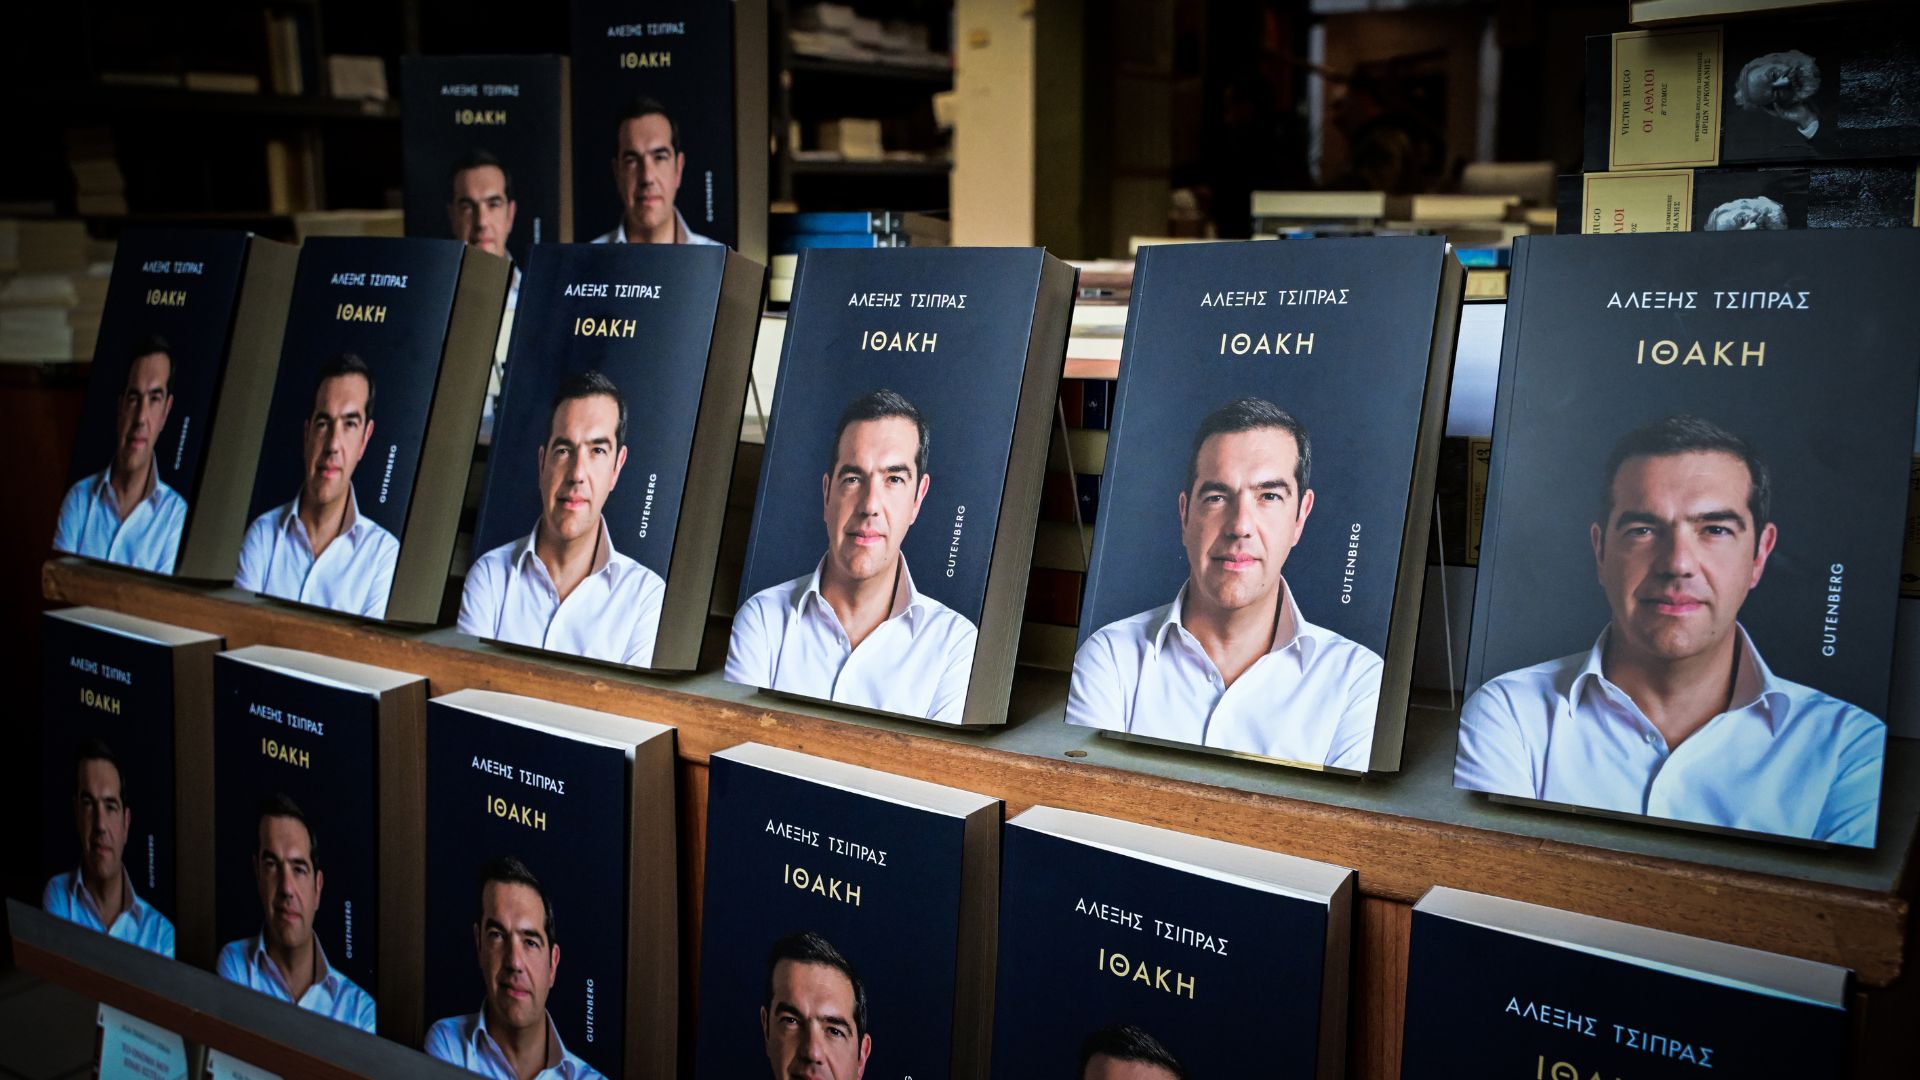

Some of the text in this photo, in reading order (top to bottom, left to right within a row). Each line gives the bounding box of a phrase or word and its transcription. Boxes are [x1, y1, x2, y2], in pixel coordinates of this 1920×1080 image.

[620, 52, 671, 68] ΙΘΑΚΗ
[455, 109, 507, 124] ΙΘΑΚΗ
[1622, 69, 1631, 136] VICTOR HUGO
[1642, 69, 1655, 133] ΟΙ ΑΘΛΙΟΙ
[1701, 110, 1710, 135] ΩΡΙΩΝ
[142, 261, 204, 274] ΑΛΕΞΗΣ ΤΣΙΠΡΑΣ
[330, 272, 409, 288] ΑΛΕΞΗΣ ΤΣΙΠΡΑΣ
[146, 289, 187, 305] ΙΘΑΚΗ
[564, 283, 662, 298] ΑΛΕΞΗΣ ΤΣΙΠΡΑΣ
[848, 292, 968, 308] ΑΛΕΞΗΣ ΤΣΙΠΡΑΣ
[1200, 288, 1350, 306] ΑΛΕΞΗΣ ΤΣΙΠΡΑΣ
[1606, 291, 1810, 308] ΑΛΕΞΗΣ ΤΣΙΠΡΑΣ
[336, 303, 387, 322] ΙΘΑΚΗ
[574, 317, 637, 338] ΙΘΑΚΗ
[861, 330, 938, 352] ΙΘΑΚΗ
[1220, 332, 1315, 354] ΙΘΑΚΗ
[1637, 339, 1766, 366] ΙΘΑΚΗ
[379, 444, 398, 503] GUTENBERG
[639, 473, 657, 537] GUTENBERG
[946, 505, 966, 577] GUTENBERG
[1341, 522, 1362, 603] GUTENBERG
[1821, 563, 1844, 656] GUTENBERG
[70, 656, 132, 684] ΑΛΕΞΗΣ ΤΣΙΠΡΑΣ
[80, 688, 121, 714] ΙΘΑΚΗ
[249, 703, 324, 735] ΑΛΕΞΗΣ ΤΣΙΠΡΑΣ
[262, 737, 310, 768] ΙΘΑΚΗ
[471, 755, 565, 794] ΑΛΕΞΗΣ ΤΣΙΠΡΑΣ
[487, 795, 546, 830] ΙΘΑΚΗ
[765, 819, 887, 866] ΑΛΕΞΗΣ ΤΣΙΠΡΑΣ
[784, 863, 861, 906] ΙΘΑΚΗ
[344, 900, 353, 958] GUTENBERG
[1075, 897, 1229, 955] ΑΛΕΞΗΣ ΤΣΙΠΡΑΣ
[1099, 948, 1196, 999] ΙΘΑΚΗ
[586, 978, 594, 1042] GUTENBERG
[1505, 996, 1713, 1067] ΑΛΕΞΗΣ ΤΣΙΠΡΑΣ
